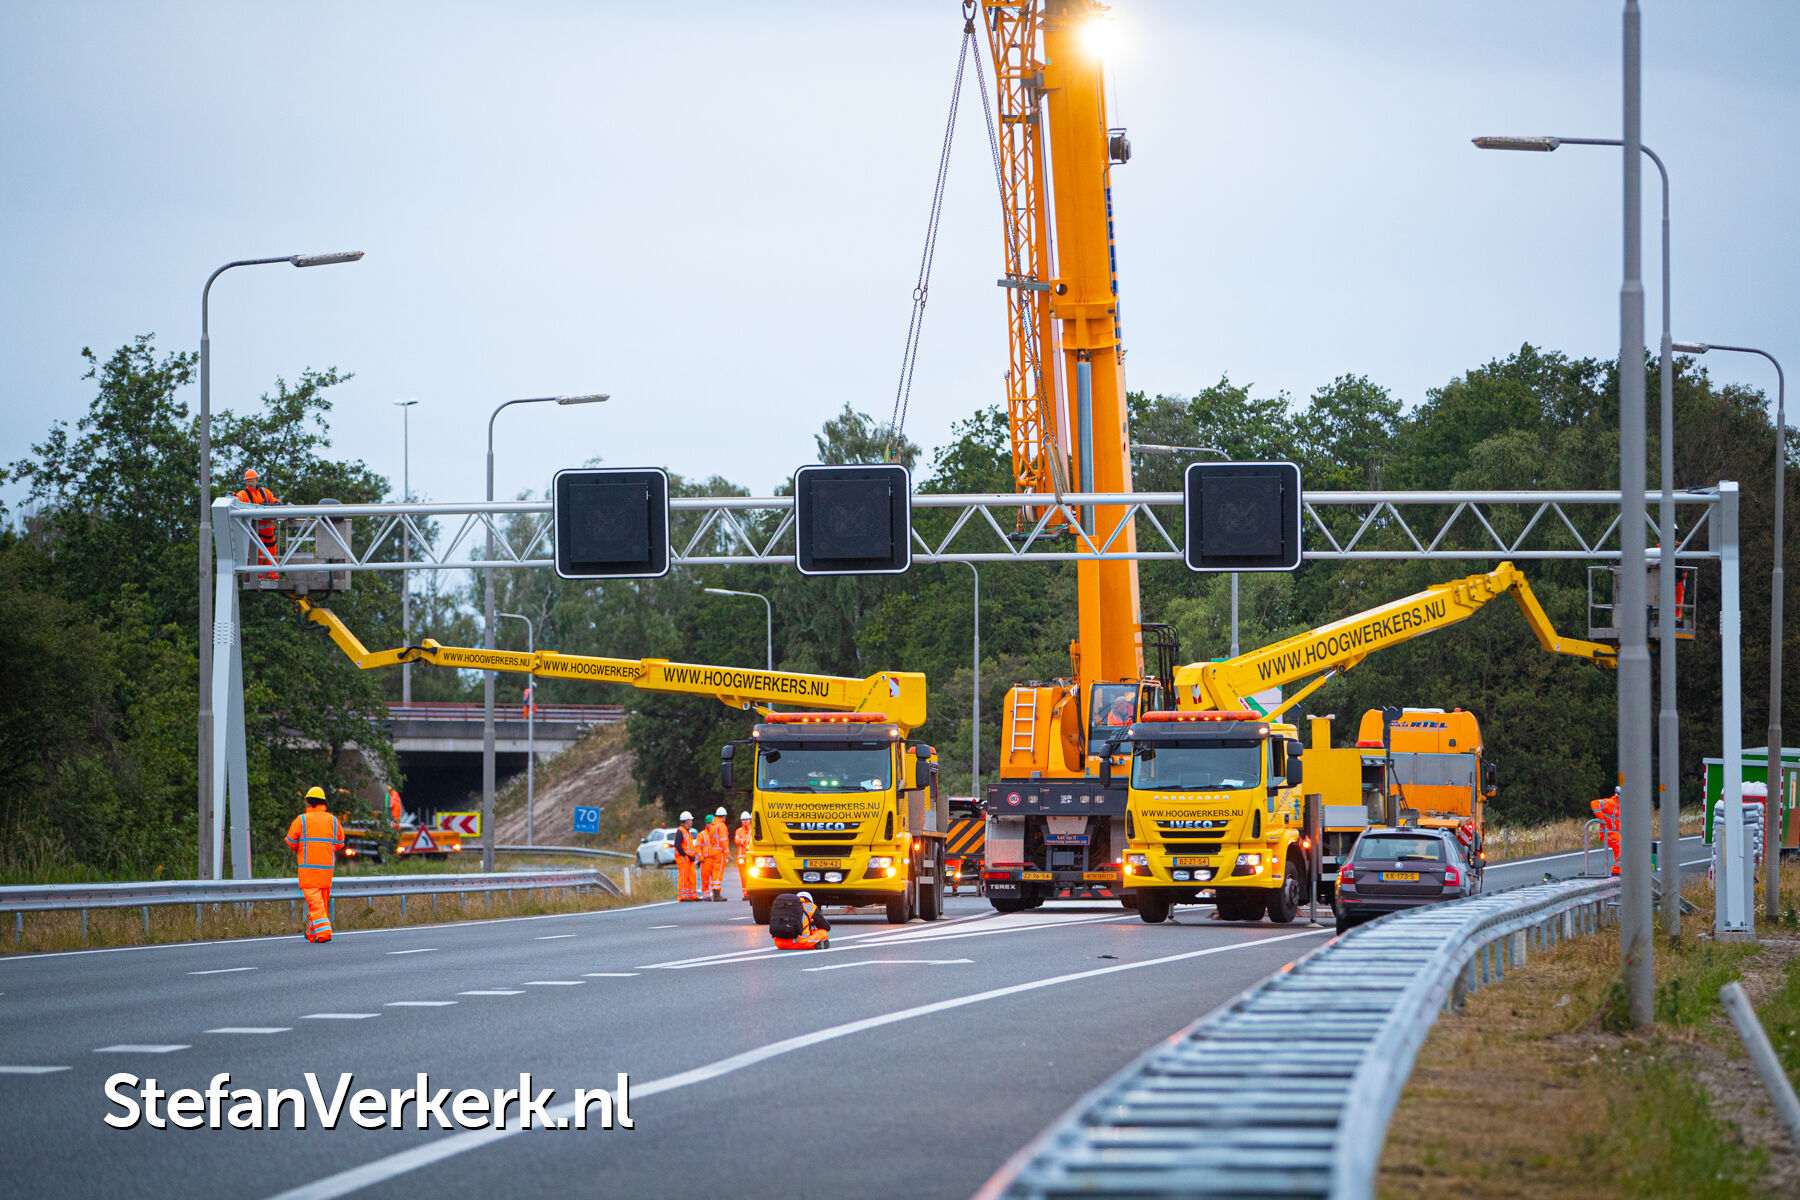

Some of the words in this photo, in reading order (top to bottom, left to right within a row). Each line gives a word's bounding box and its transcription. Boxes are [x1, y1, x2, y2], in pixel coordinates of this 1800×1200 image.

[1257, 599, 1446, 681] WWW.HOOGWERKERS.NU
[443, 652, 530, 667] WWW.HOOGWERKERS.NU
[663, 667, 829, 697] WWW.HOOGWERKERS.NU
[768, 802, 880, 811] WWW.HOOGWERKERS.NU
[578, 808, 597, 822] 70
[1141, 809, 1244, 818] WWW.HOOGWERKERS.NU
[800, 822, 845, 831] IVECO
[1170, 820, 1213, 829] IVECO
